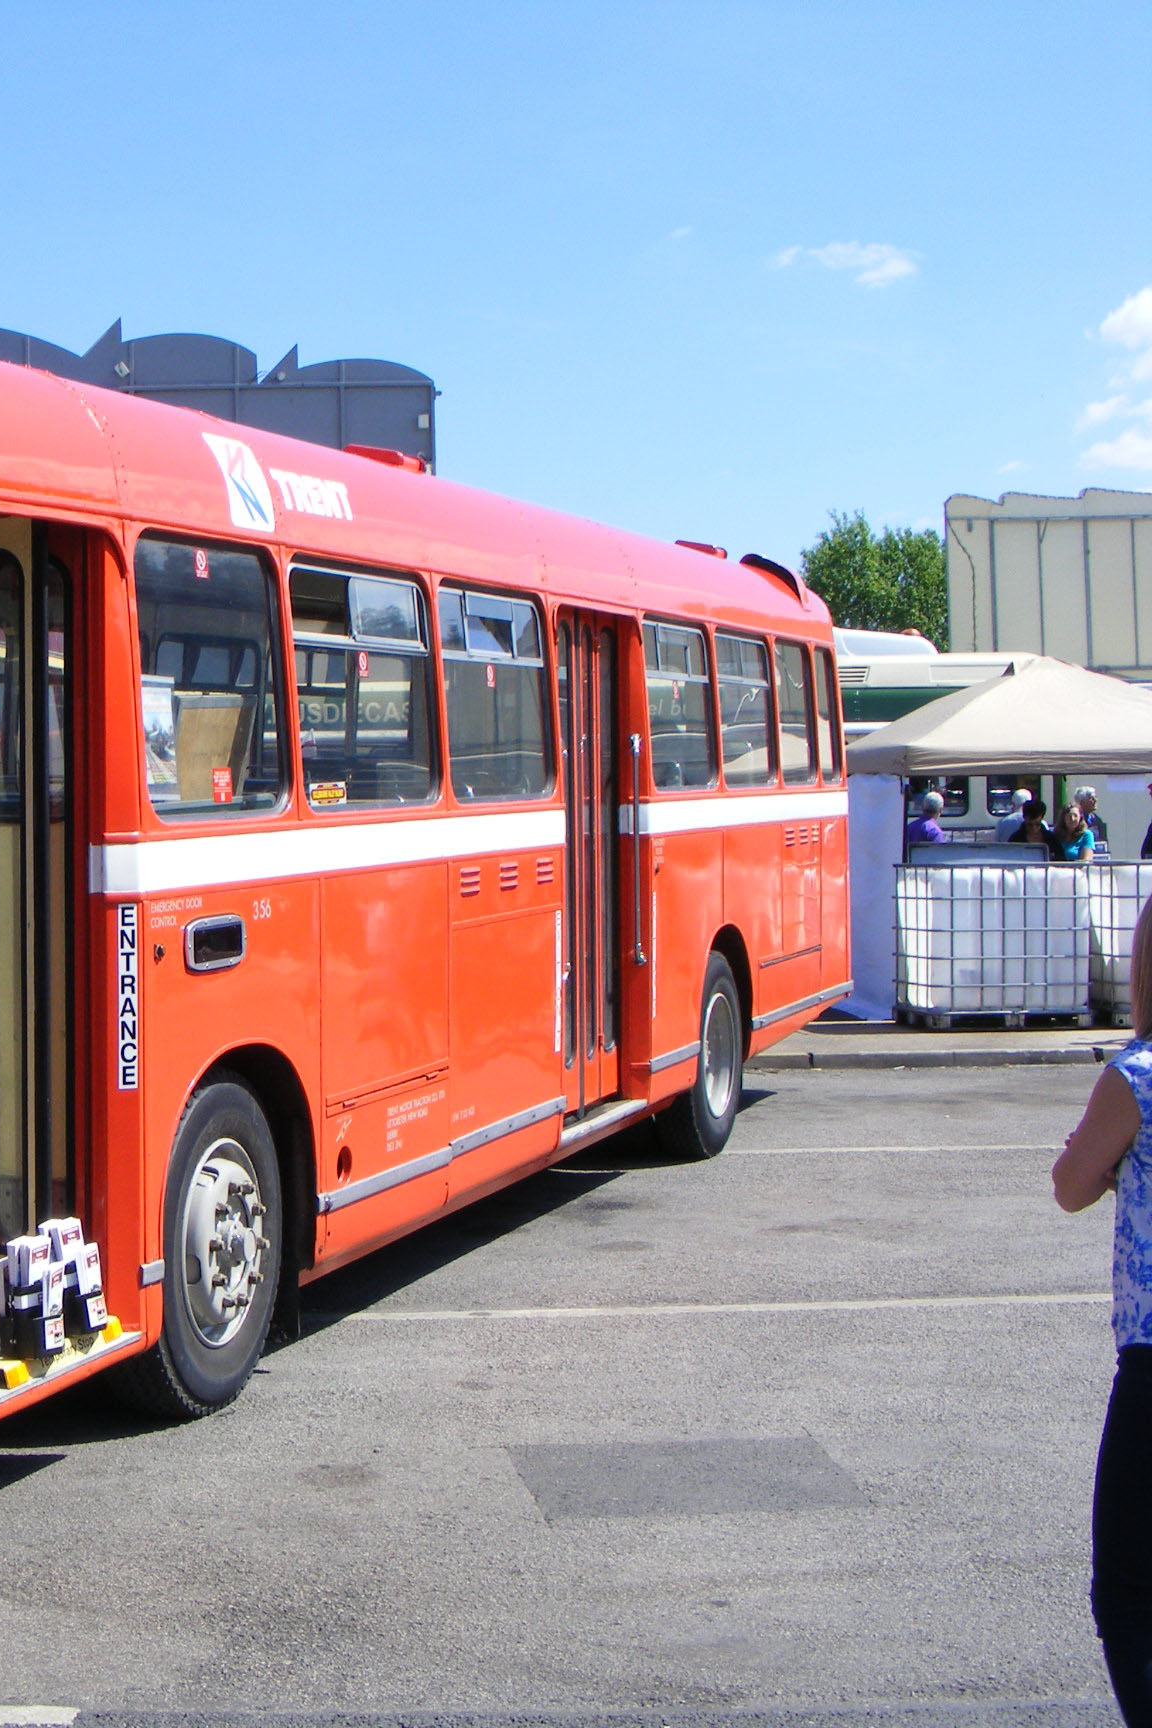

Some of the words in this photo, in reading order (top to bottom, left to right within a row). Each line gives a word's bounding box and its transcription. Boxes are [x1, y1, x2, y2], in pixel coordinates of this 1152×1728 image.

[269, 468, 353, 521] TRENT
[151, 900, 184, 913] EMERGENCY
[253, 899, 272, 920] 356
[151, 915, 177, 928] CONTROL
[120, 906, 137, 1085] ENTRANCE
